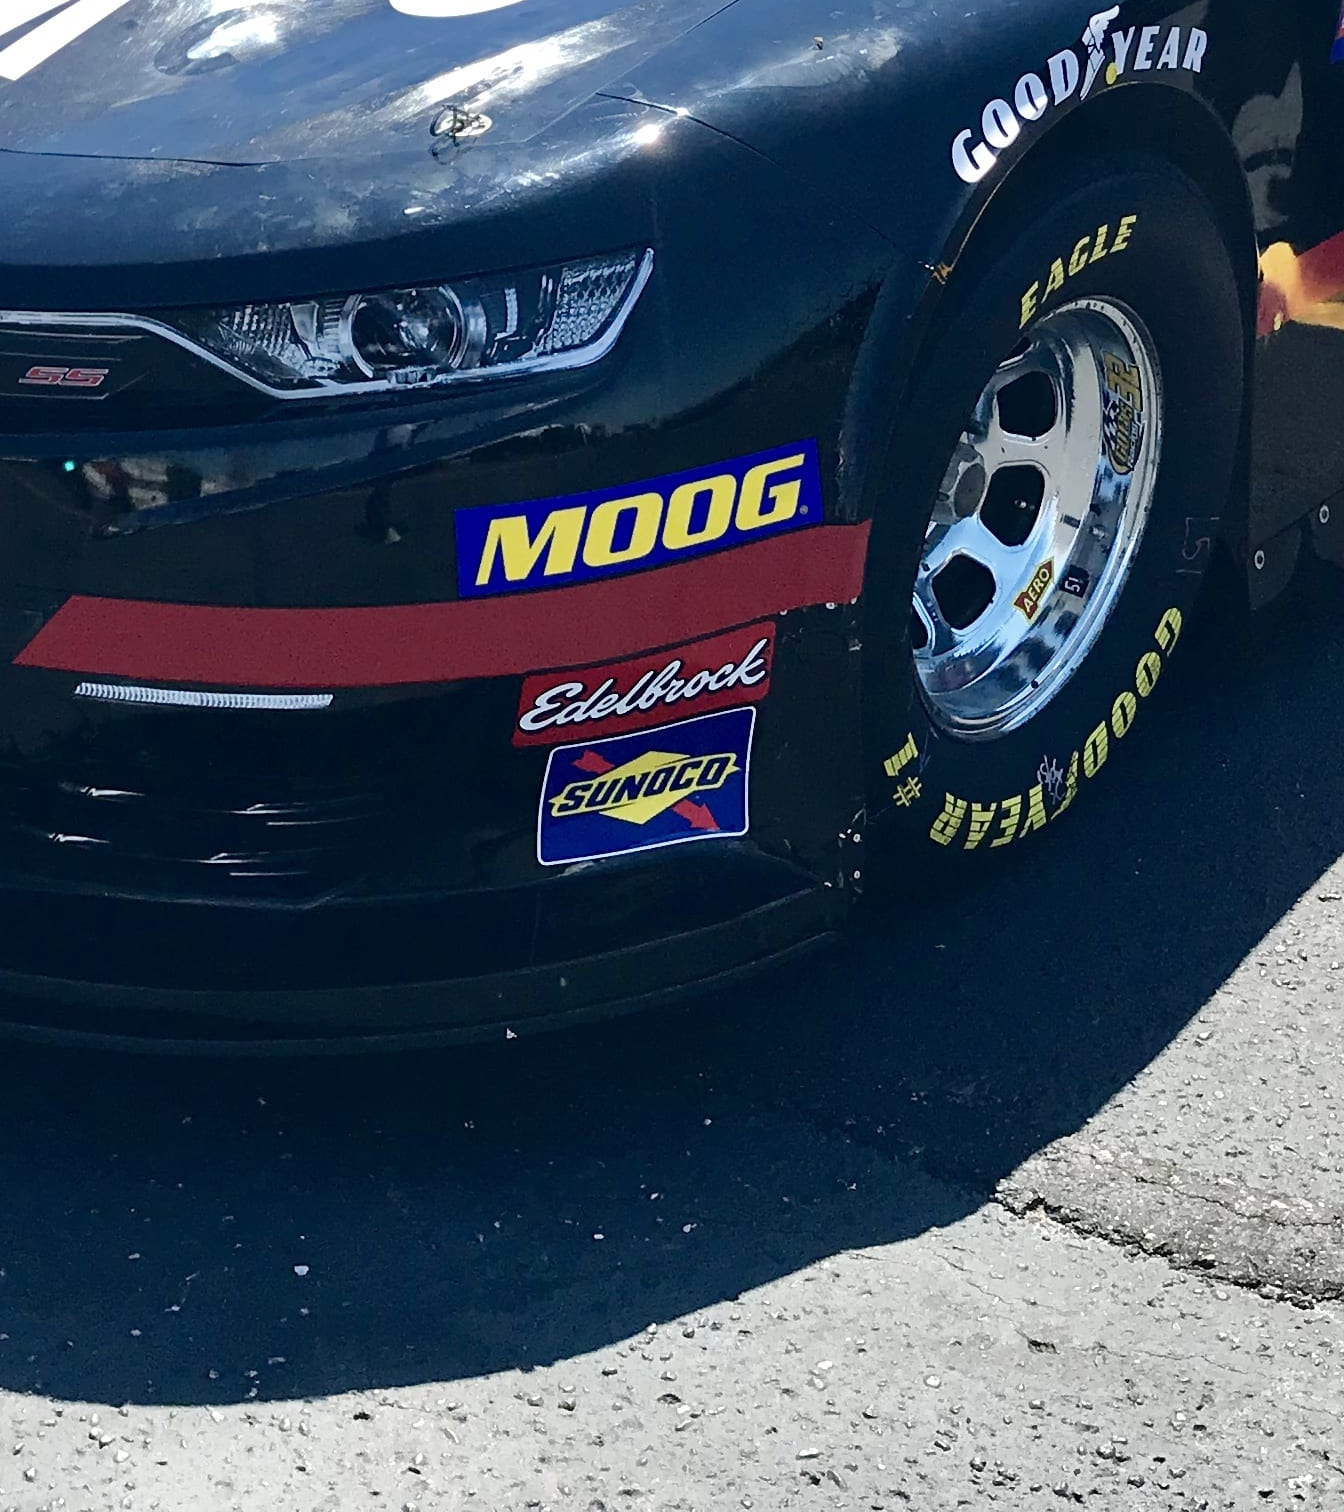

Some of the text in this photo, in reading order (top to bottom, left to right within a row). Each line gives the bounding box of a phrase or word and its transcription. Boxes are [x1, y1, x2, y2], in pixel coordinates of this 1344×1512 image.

[1019, 214, 1137, 330] EAGLE
[18, 366, 109, 387] SS
[474, 452, 806, 587] MOOG
[1022, 567, 1052, 614] AERO
[518, 637, 769, 731] Edelbrock
[929, 606, 1183, 850] GOODYEAR
[557, 753, 732, 812] SUNOCO
